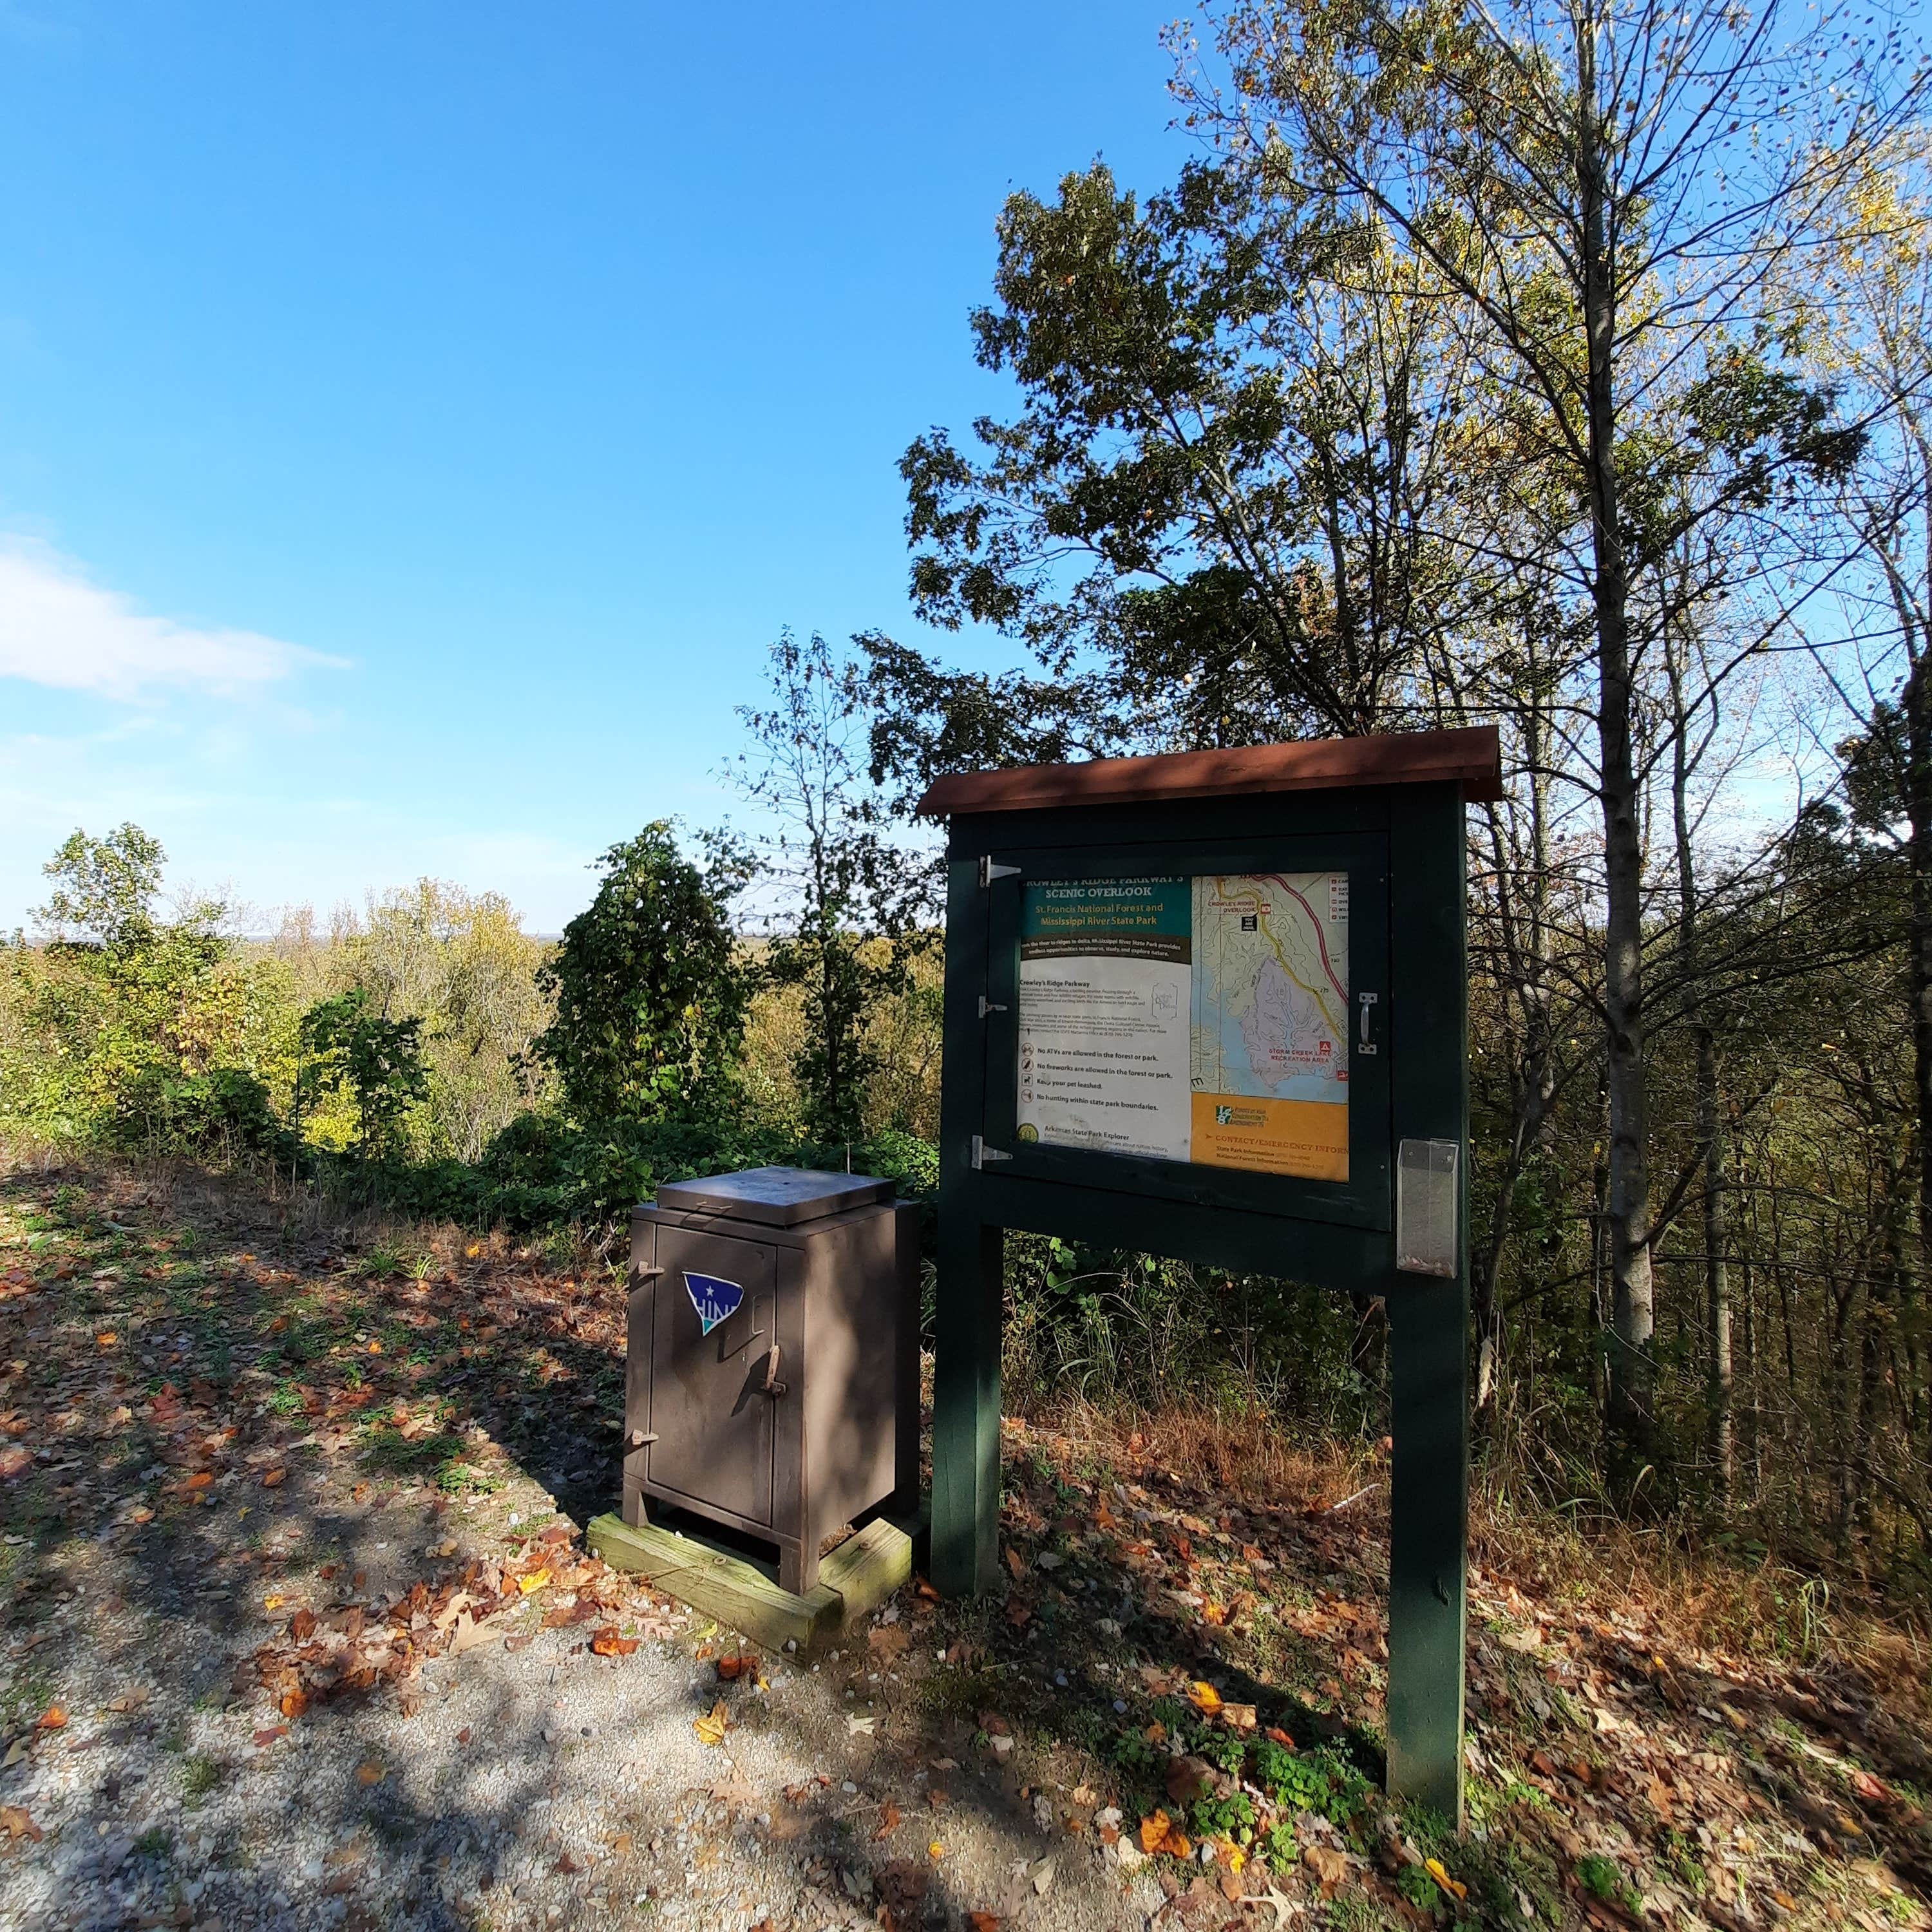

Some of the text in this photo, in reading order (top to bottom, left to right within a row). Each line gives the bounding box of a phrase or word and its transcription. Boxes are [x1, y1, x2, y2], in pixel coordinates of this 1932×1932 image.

[1023, 878, 1078, 887] ROWLEYS
[1119, 876, 1184, 884] PARKWAYS
[1045, 886, 1151, 898] SCENIC OVERLOOK
[1035, 902, 1164, 914] St. Francis National Forest and
[1040, 914, 1158, 927] Mississippi River State Park
[1158, 942, 1181, 951] provides
[1019, 979, 1090, 989] Crowley's Ridge Parkway
[1072, 1049, 1096, 1058] allowed
[1115, 1052, 1133, 1060] forest
[1142, 1054, 1159, 1062] park.
[1046, 1063, 1073, 1072] fireworks
[1085, 1066, 1108, 1075] allowed
[1117, 1068, 1127, 1076] the
[1128, 1068, 1147, 1077] forest
[1156, 1071, 1173, 1079] park.
[1077, 1081, 1103, 1090] leashed.
[1045, 1094, 1069, 1104] hunting
[1070, 1095, 1089, 1104] within
[1090, 1098, 1104, 1106] state
[1105, 1099, 1120, 1108] park
[1121, 1101, 1159, 1112] boundaries.
[1045, 1125, 1072, 1136] Arkansas
[1072, 1128, 1088, 1137] State
[1088, 1128, 1103, 1138] Park
[1104, 1130, 1130, 1142] Explorer
[1216, 1135, 1312, 1151] CONTACT/EMERGENCY
